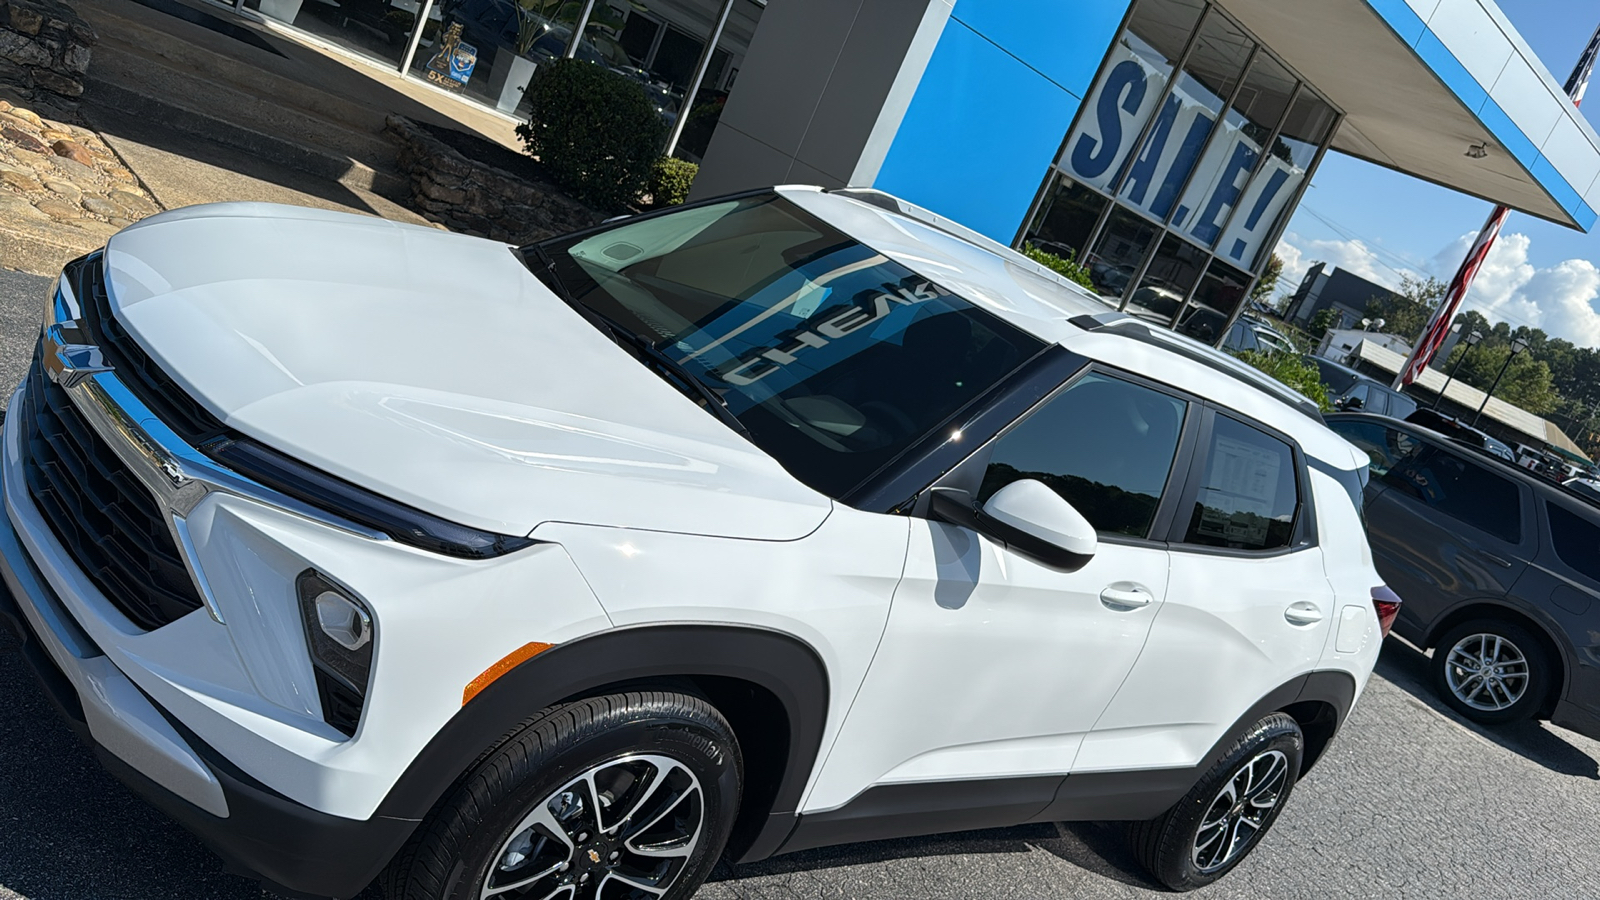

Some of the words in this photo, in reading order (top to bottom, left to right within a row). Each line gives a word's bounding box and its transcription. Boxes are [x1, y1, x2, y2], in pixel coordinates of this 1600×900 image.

[427, 70, 445, 84] 5X
[1071, 60, 1290, 261] SALE!
[652, 726, 721, 760] Cnental
